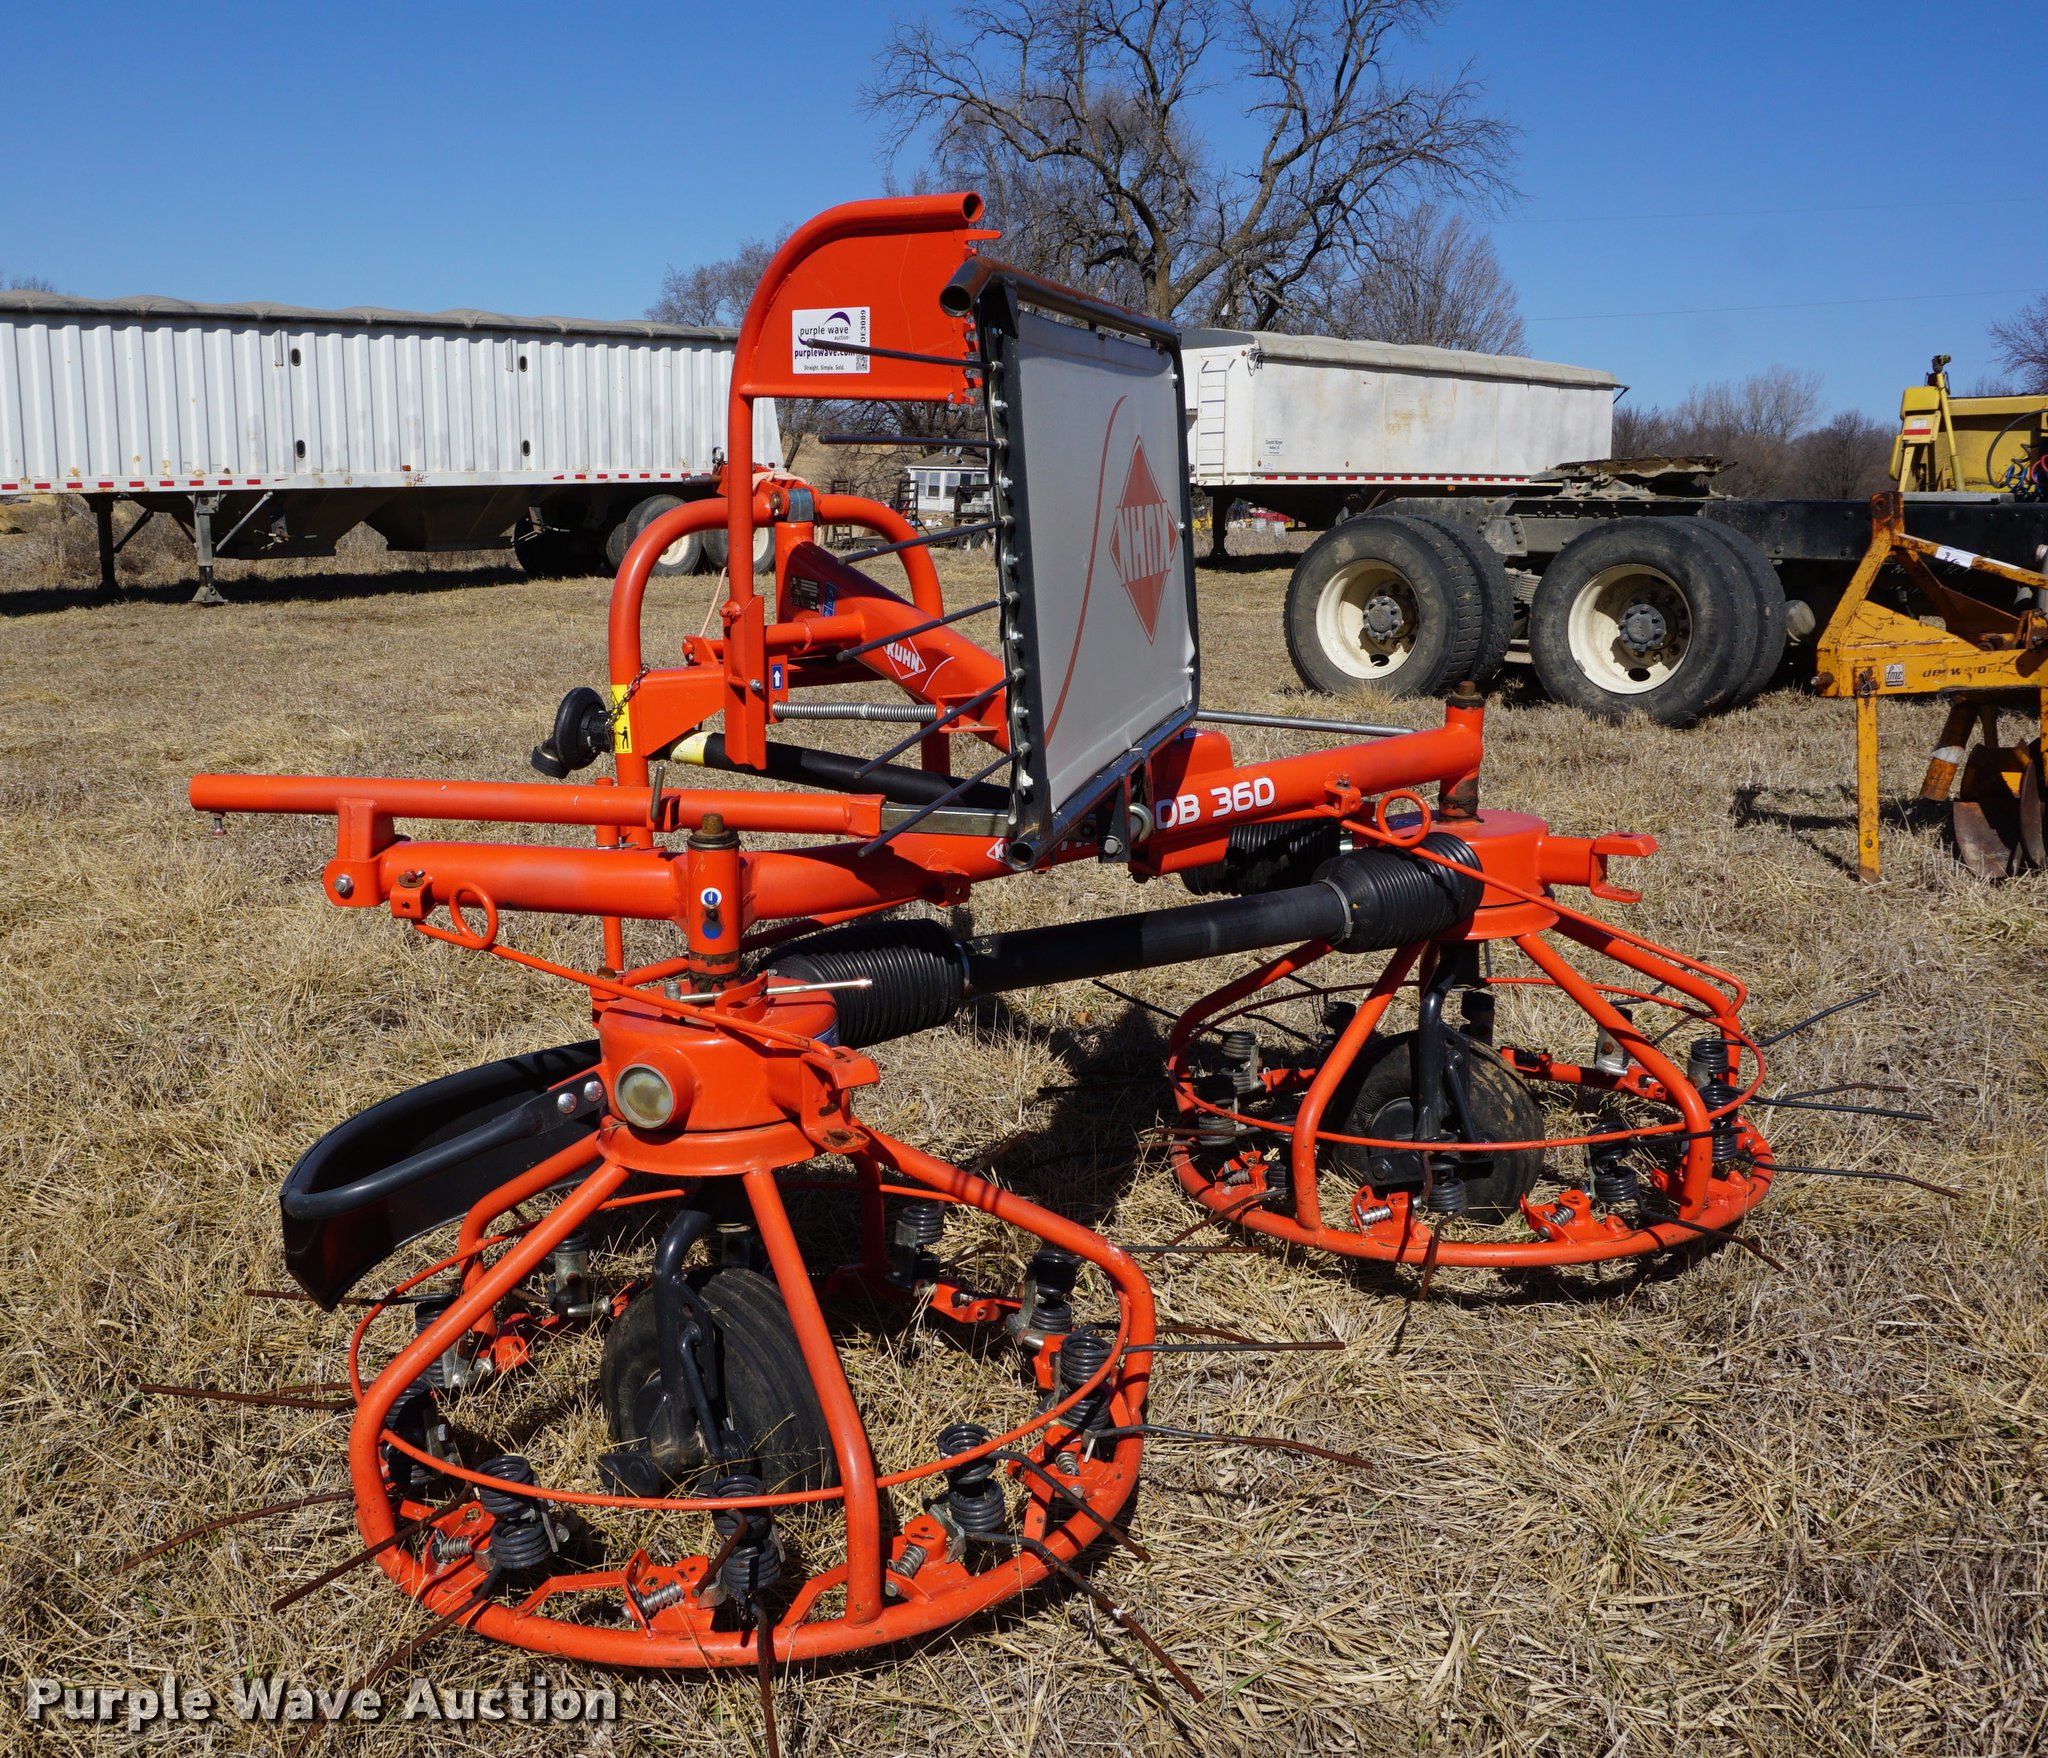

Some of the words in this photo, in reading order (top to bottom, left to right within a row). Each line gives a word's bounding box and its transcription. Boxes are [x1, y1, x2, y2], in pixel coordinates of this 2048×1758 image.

[800, 325, 825, 337] purple
[828, 326, 849, 334] wave
[886, 642, 922, 674] KUHN
[1886, 665, 1903, 680] fmc
[1211, 777, 1275, 818] 360
